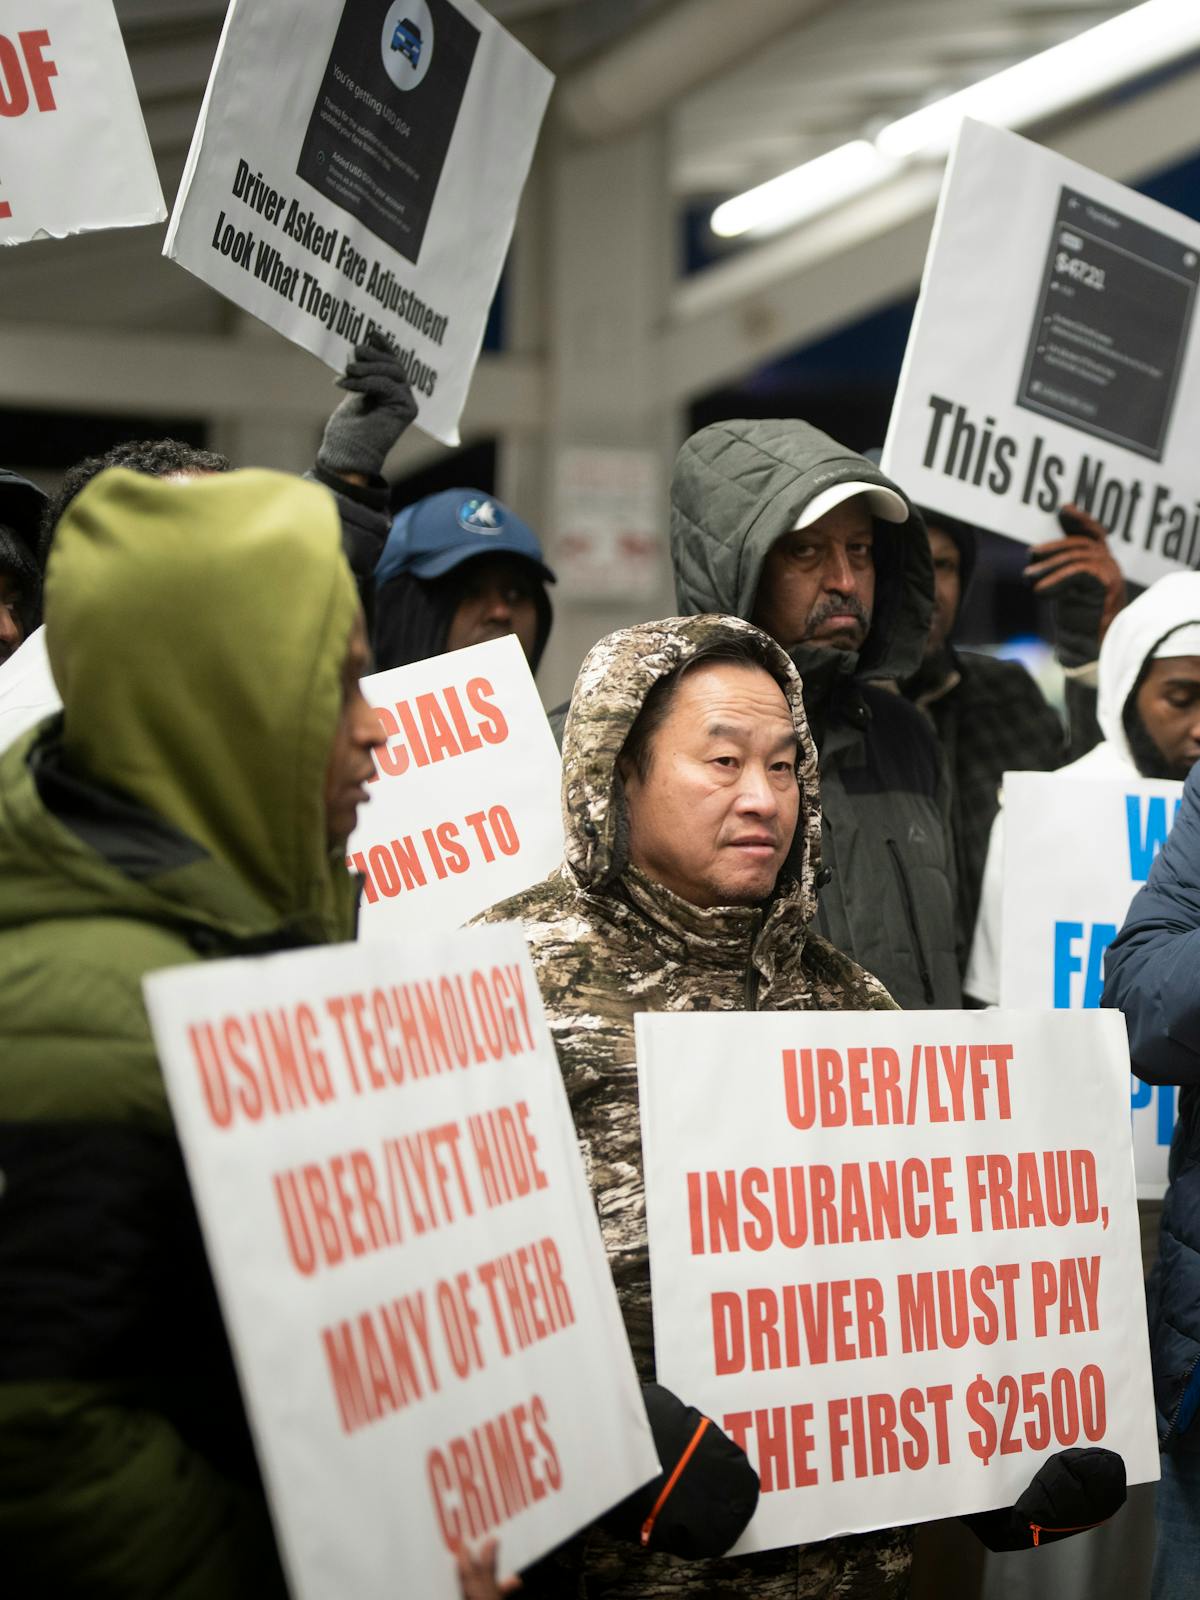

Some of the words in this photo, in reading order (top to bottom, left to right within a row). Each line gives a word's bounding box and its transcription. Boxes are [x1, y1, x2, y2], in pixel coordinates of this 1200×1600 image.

[212, 211, 256, 271] Look
[254, 240, 299, 302] What
[232, 158, 287, 226] Driver
[282, 199, 338, 264] Asked
[335, 235, 368, 287] Fare
[366, 261, 448, 346] Adjustment
[922, 395, 1018, 495] This
[1022, 436, 1065, 515] Is
[1073, 455, 1141, 544] Not
[367, 676, 510, 784] CIALS
[345, 834, 428, 905] ION
[421, 821, 471, 881] IS
[464, 804, 521, 864] TO
[187, 1000, 336, 1132] USING
[325, 963, 536, 1096] TECHNOLOGY
[781, 1043, 1015, 1131] UBER/LYFT
[272, 1121, 476, 1279] UBER/LYFT
[466, 1100, 549, 1217] HIDE
[686, 1155, 958, 1256] INSURANCE
[965, 1149, 1110, 1232] FRAUD,
[320, 1292, 441, 1437] MANY
[434, 1270, 485, 1379] OF
[477, 1236, 576, 1358] THEIR
[710, 1276, 888, 1377] DRIVER
[897, 1263, 1021, 1355] MUST
[1030, 1255, 1102, 1338] PAY
[425, 1393, 564, 1556] CRIMES
[724, 1401, 819, 1495] THE
[828, 1383, 954, 1483] FIRST
[966, 1363, 1108, 1467] $2500
